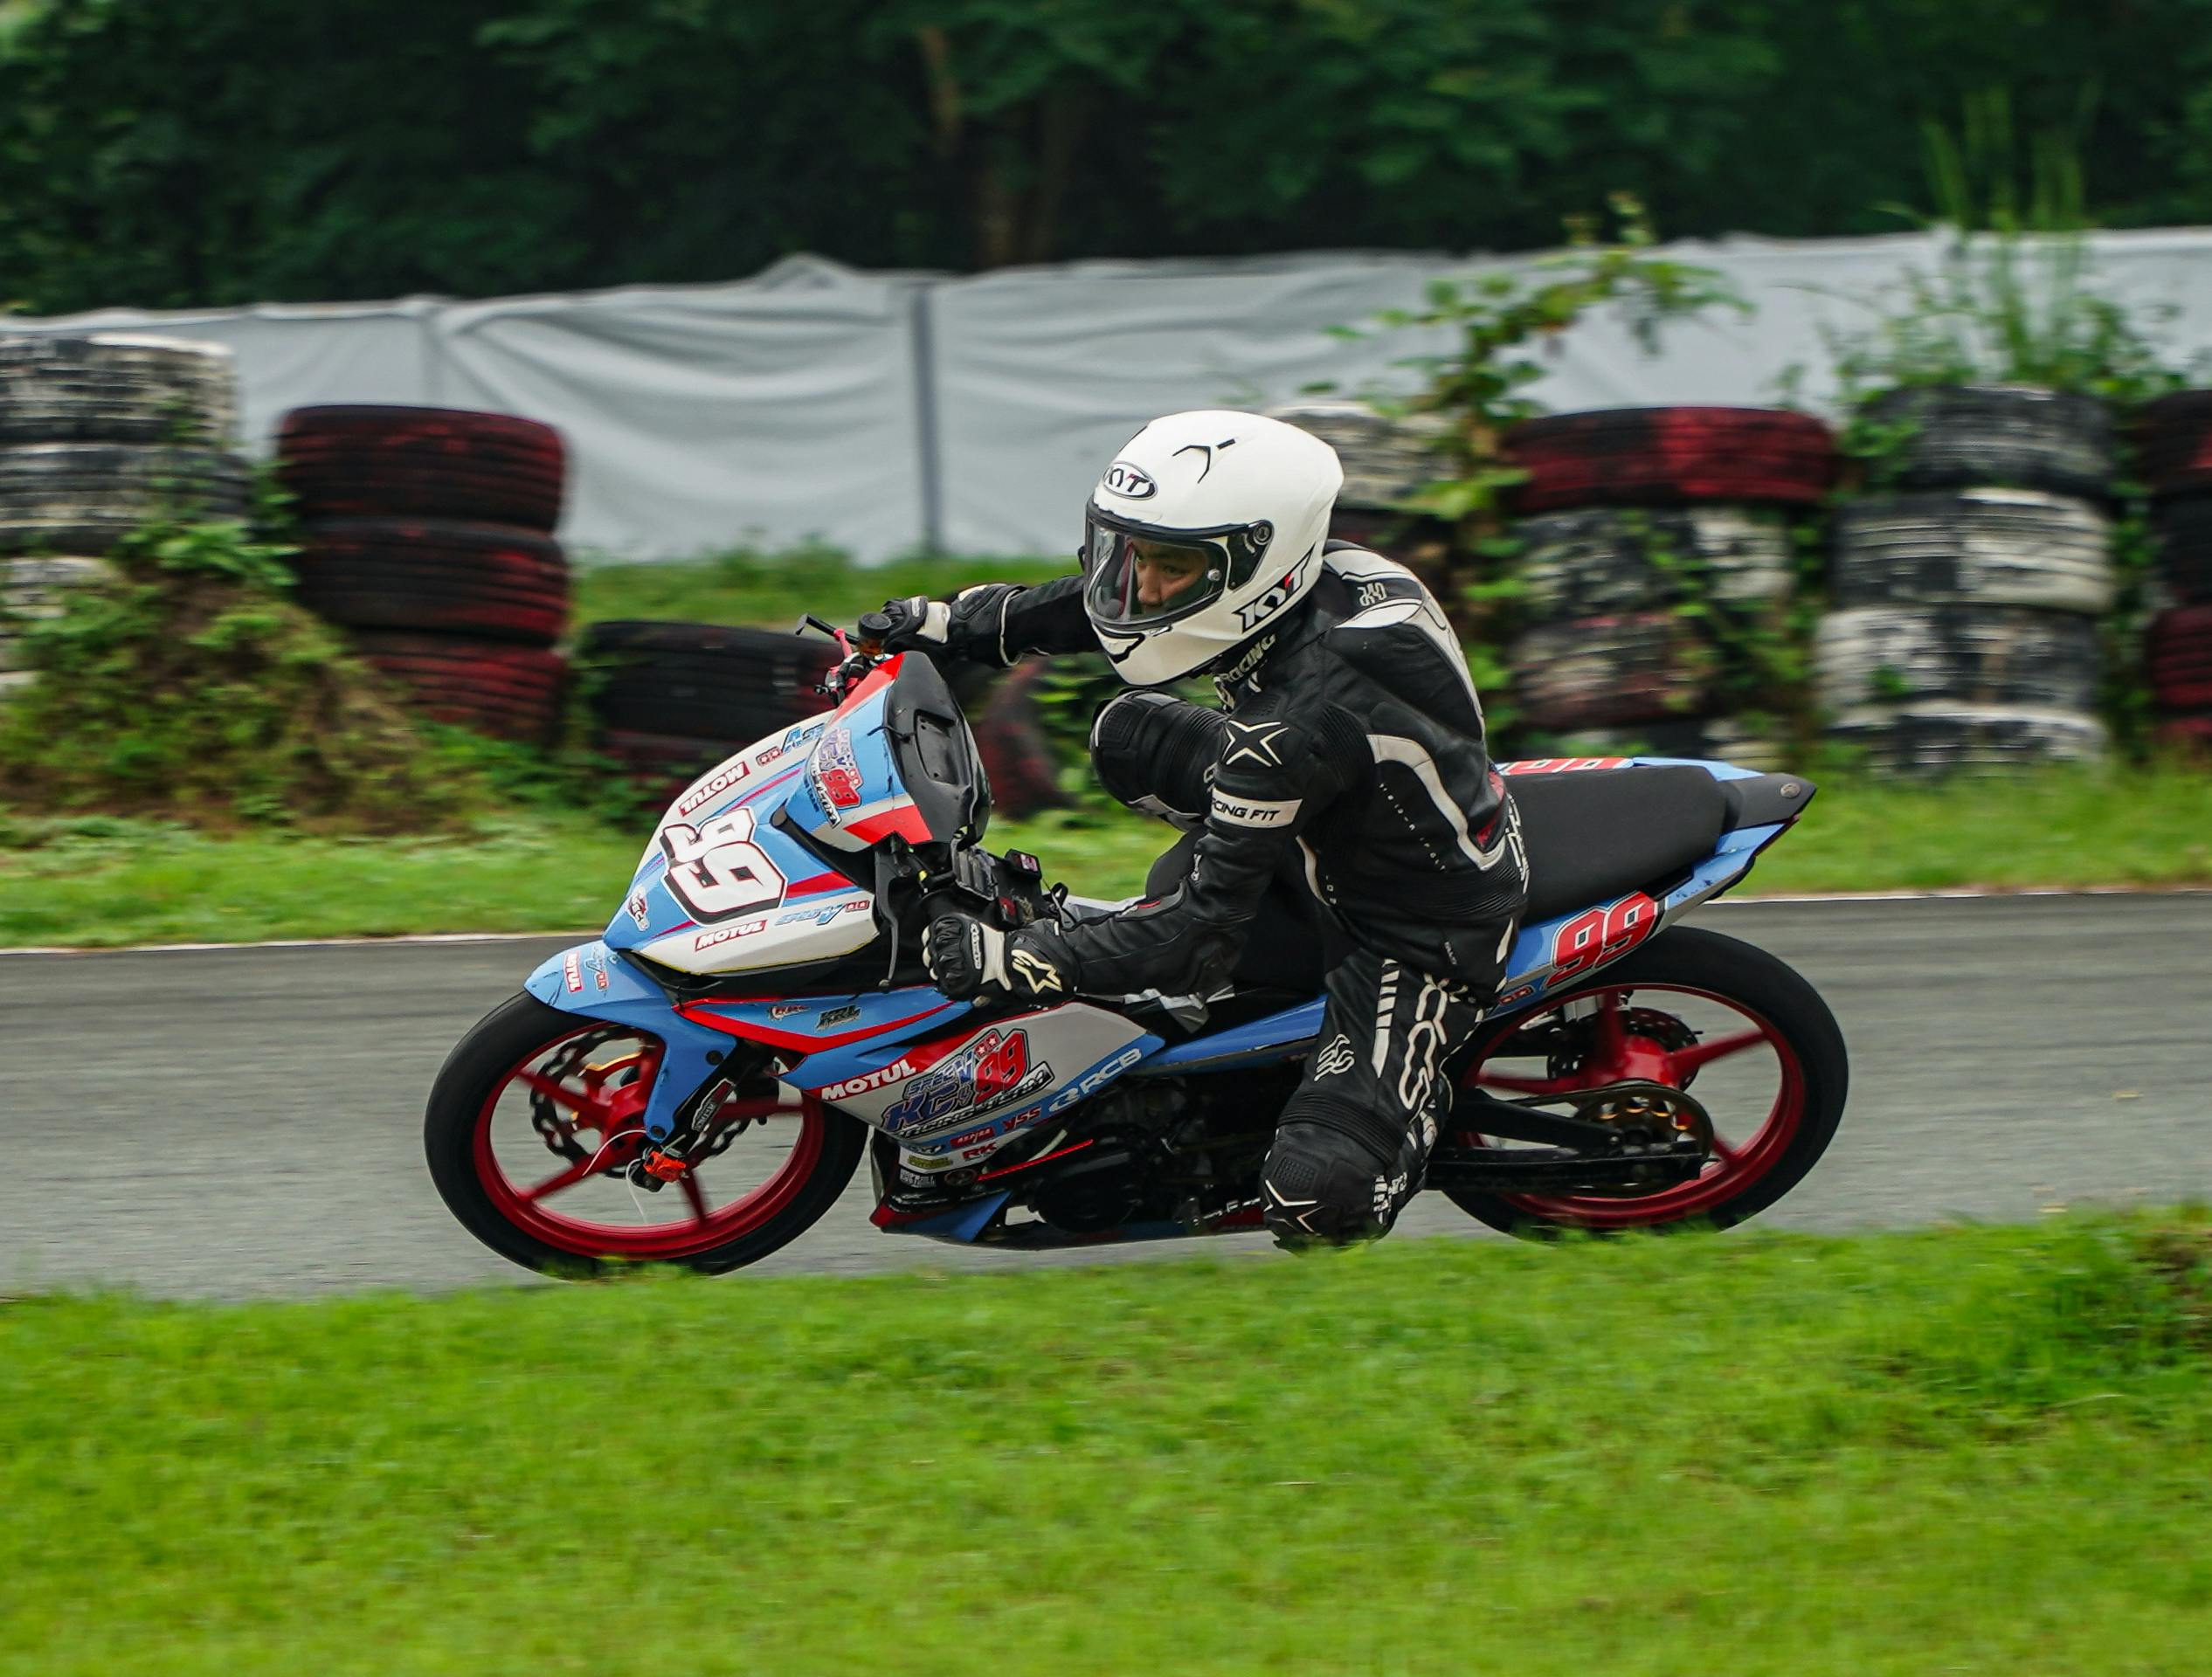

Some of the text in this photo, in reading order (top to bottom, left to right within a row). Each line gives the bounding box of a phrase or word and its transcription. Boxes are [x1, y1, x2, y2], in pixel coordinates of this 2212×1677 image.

[1234, 545, 1314, 632] KYT
[681, 761, 746, 814] MOTUL
[1212, 797, 1281, 822] CING FIT
[696, 920, 765, 950] MOTUL
[1545, 891, 1656, 989] 99
[821, 1059, 917, 1101] MOTUL
[973, 1031, 1027, 1105] 99
[1079, 1047, 1142, 1094] RCB
[1002, 1107, 1042, 1132] YSS
[963, 1143, 997, 1161] RK
